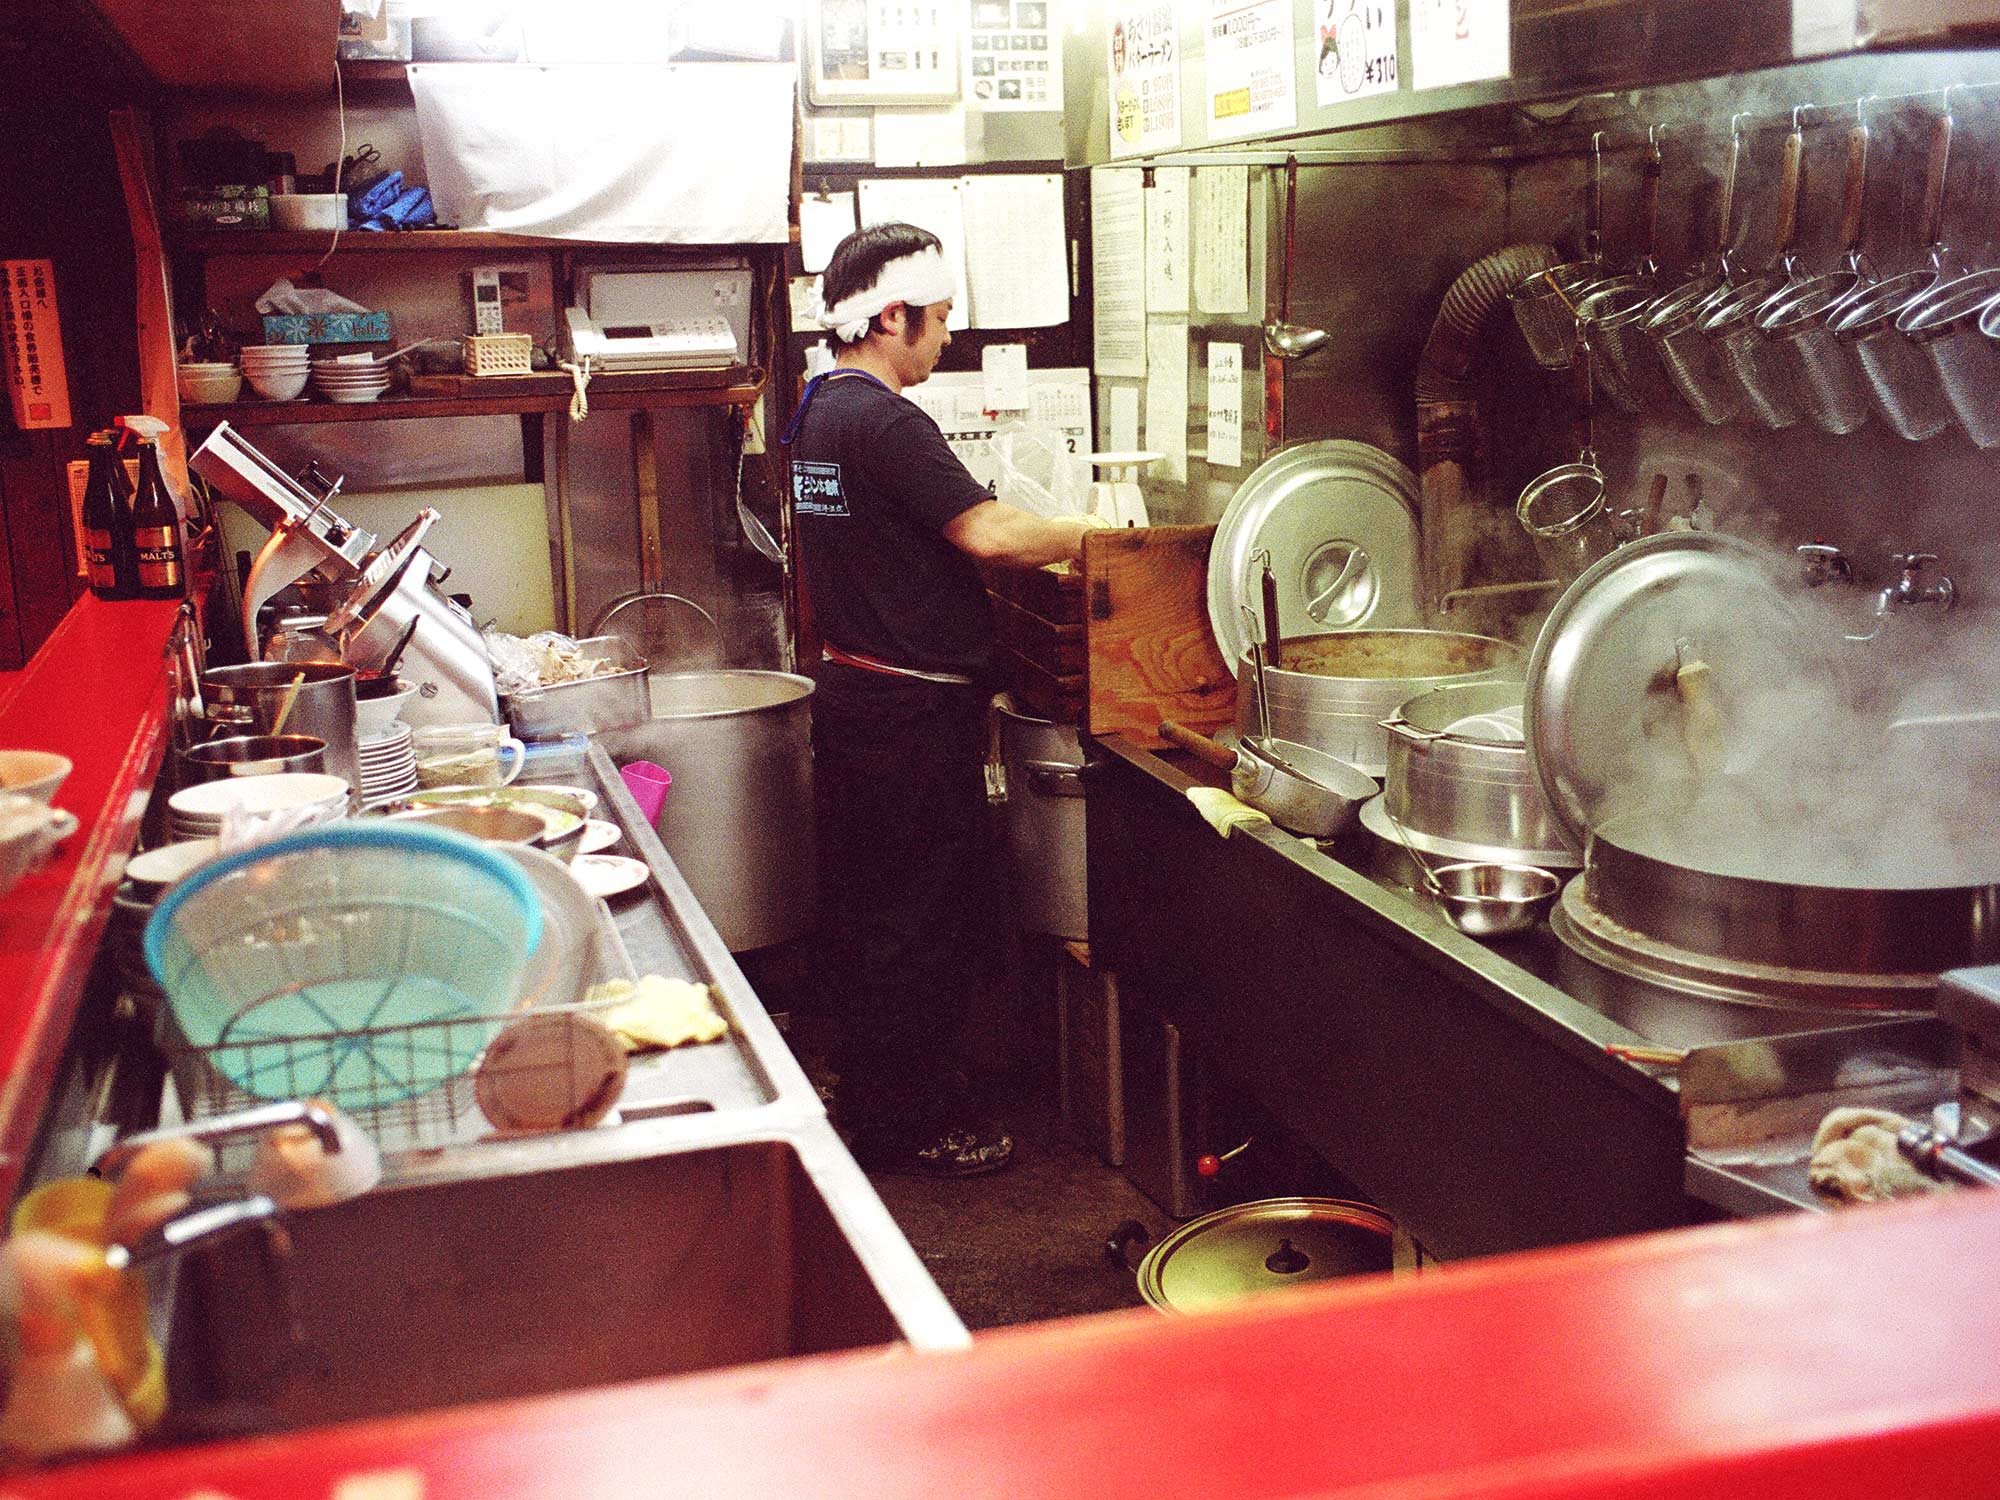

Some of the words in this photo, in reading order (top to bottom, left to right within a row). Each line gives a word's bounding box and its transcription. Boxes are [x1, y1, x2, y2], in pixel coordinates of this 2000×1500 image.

[1365, 54, 1396, 84] ¥310
[1066, 438, 1076, 453] 2
[987, 479, 996, 494] 6
